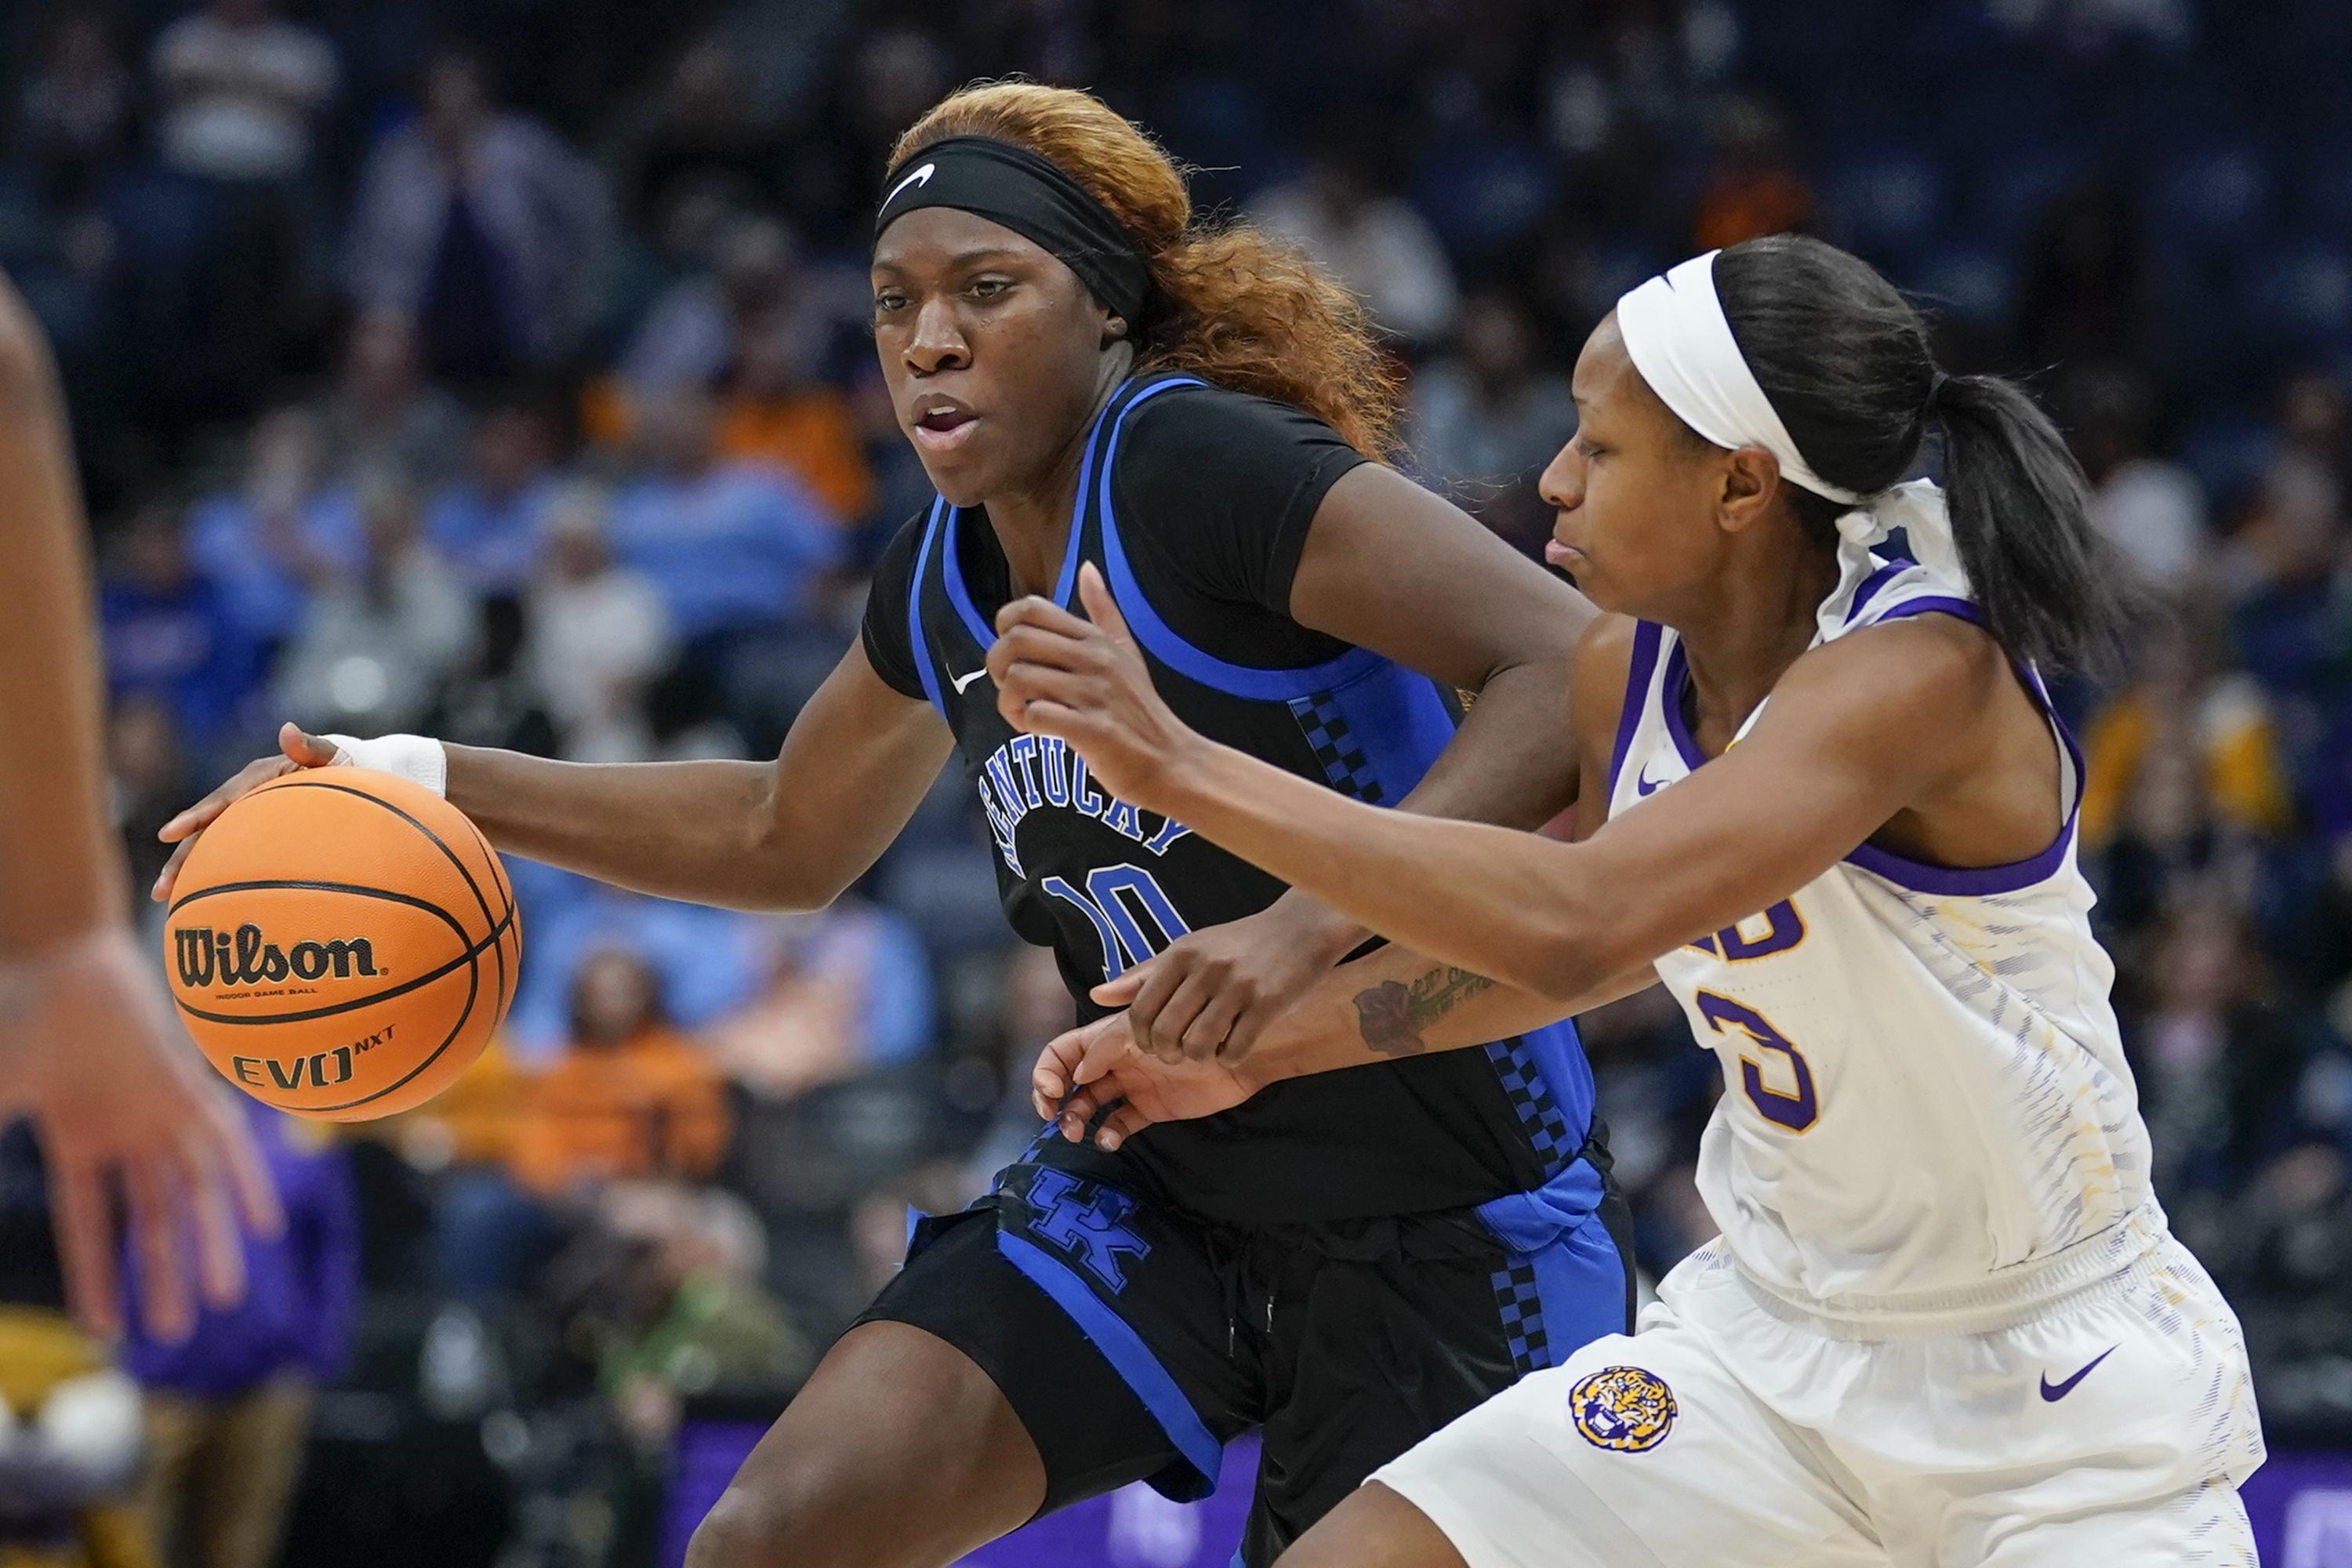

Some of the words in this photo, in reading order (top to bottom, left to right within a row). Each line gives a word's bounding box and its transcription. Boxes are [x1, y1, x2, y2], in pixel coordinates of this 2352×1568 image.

[175, 923, 378, 988] Wilson
[1041, 862, 1192, 984] 10
[215, 992, 251, 1000] INDOOR
[254, 989, 285, 998] GAME
[354, 1024, 396, 1056] NXT
[1695, 986, 1820, 1135] 3
